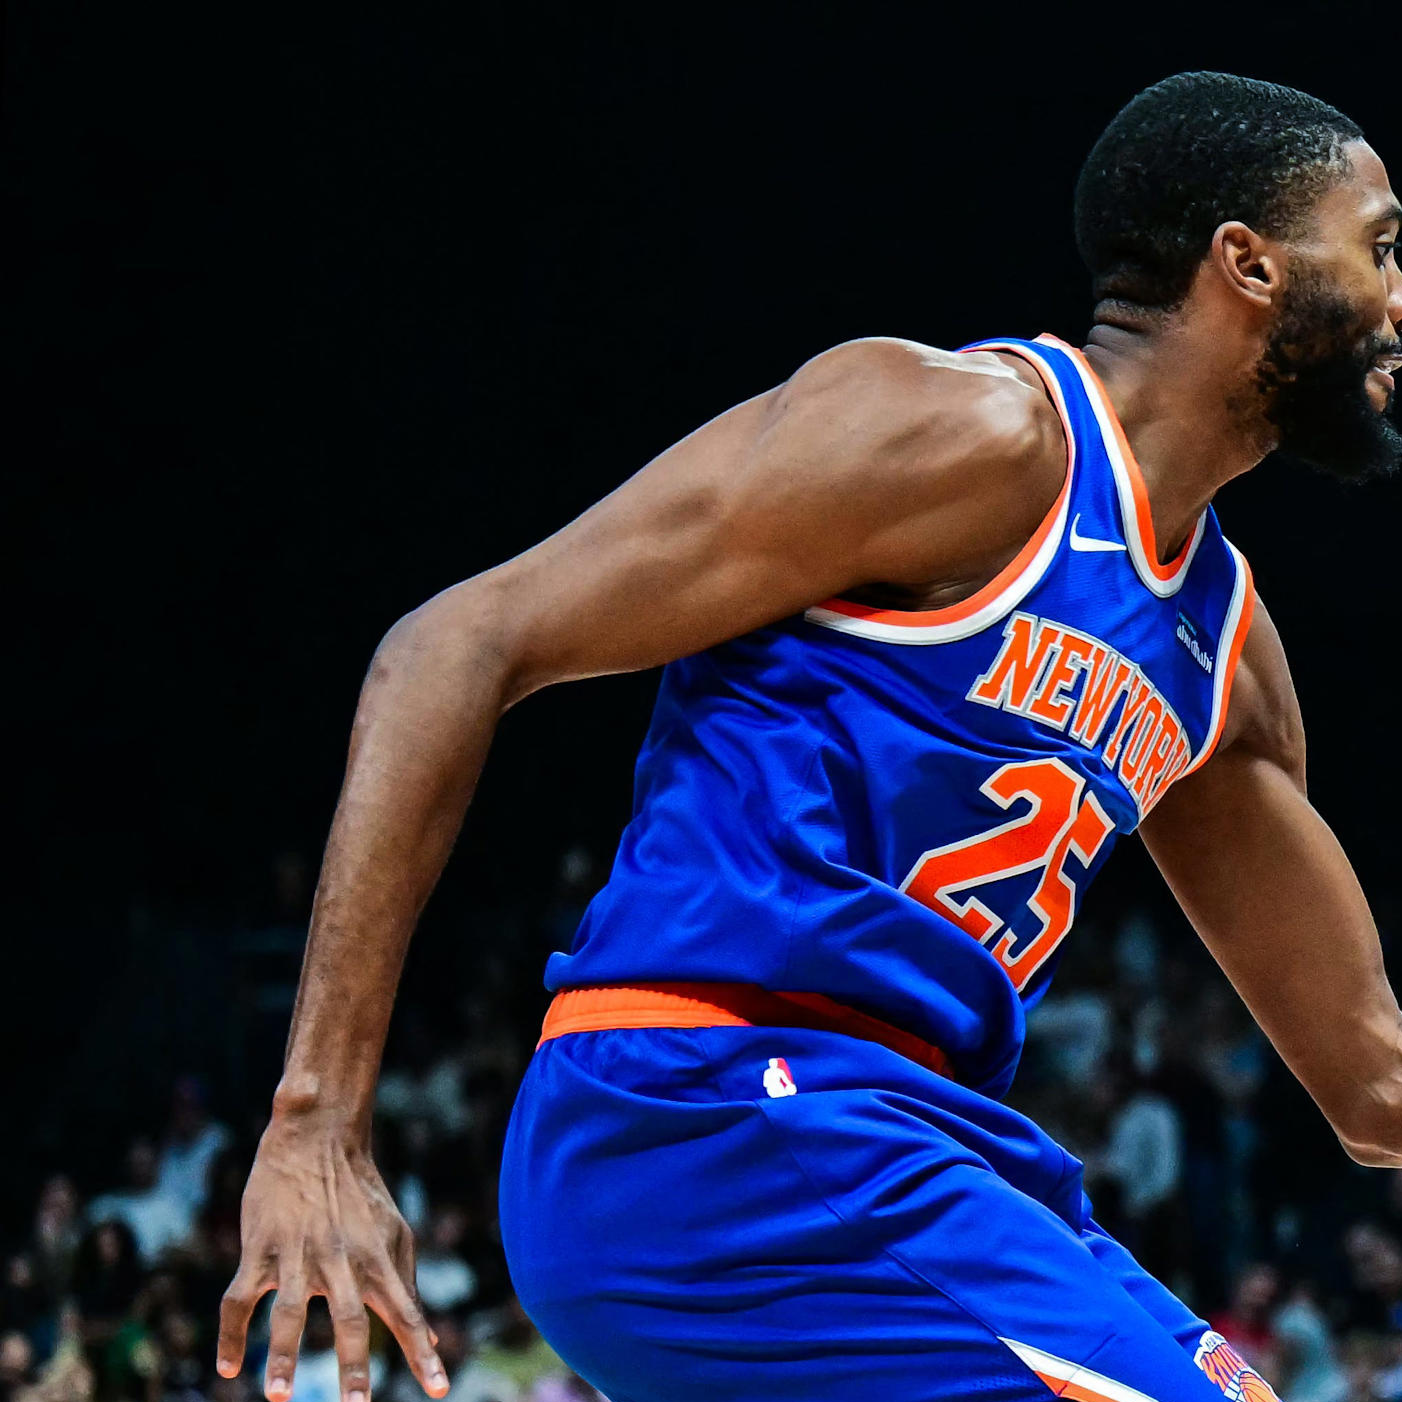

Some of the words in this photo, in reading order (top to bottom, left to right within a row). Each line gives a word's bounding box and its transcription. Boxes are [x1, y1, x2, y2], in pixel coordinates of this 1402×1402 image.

[965, 610, 1139, 750] NEW
[1101, 665, 1192, 824] YORK
[898, 756, 1116, 994] 25
